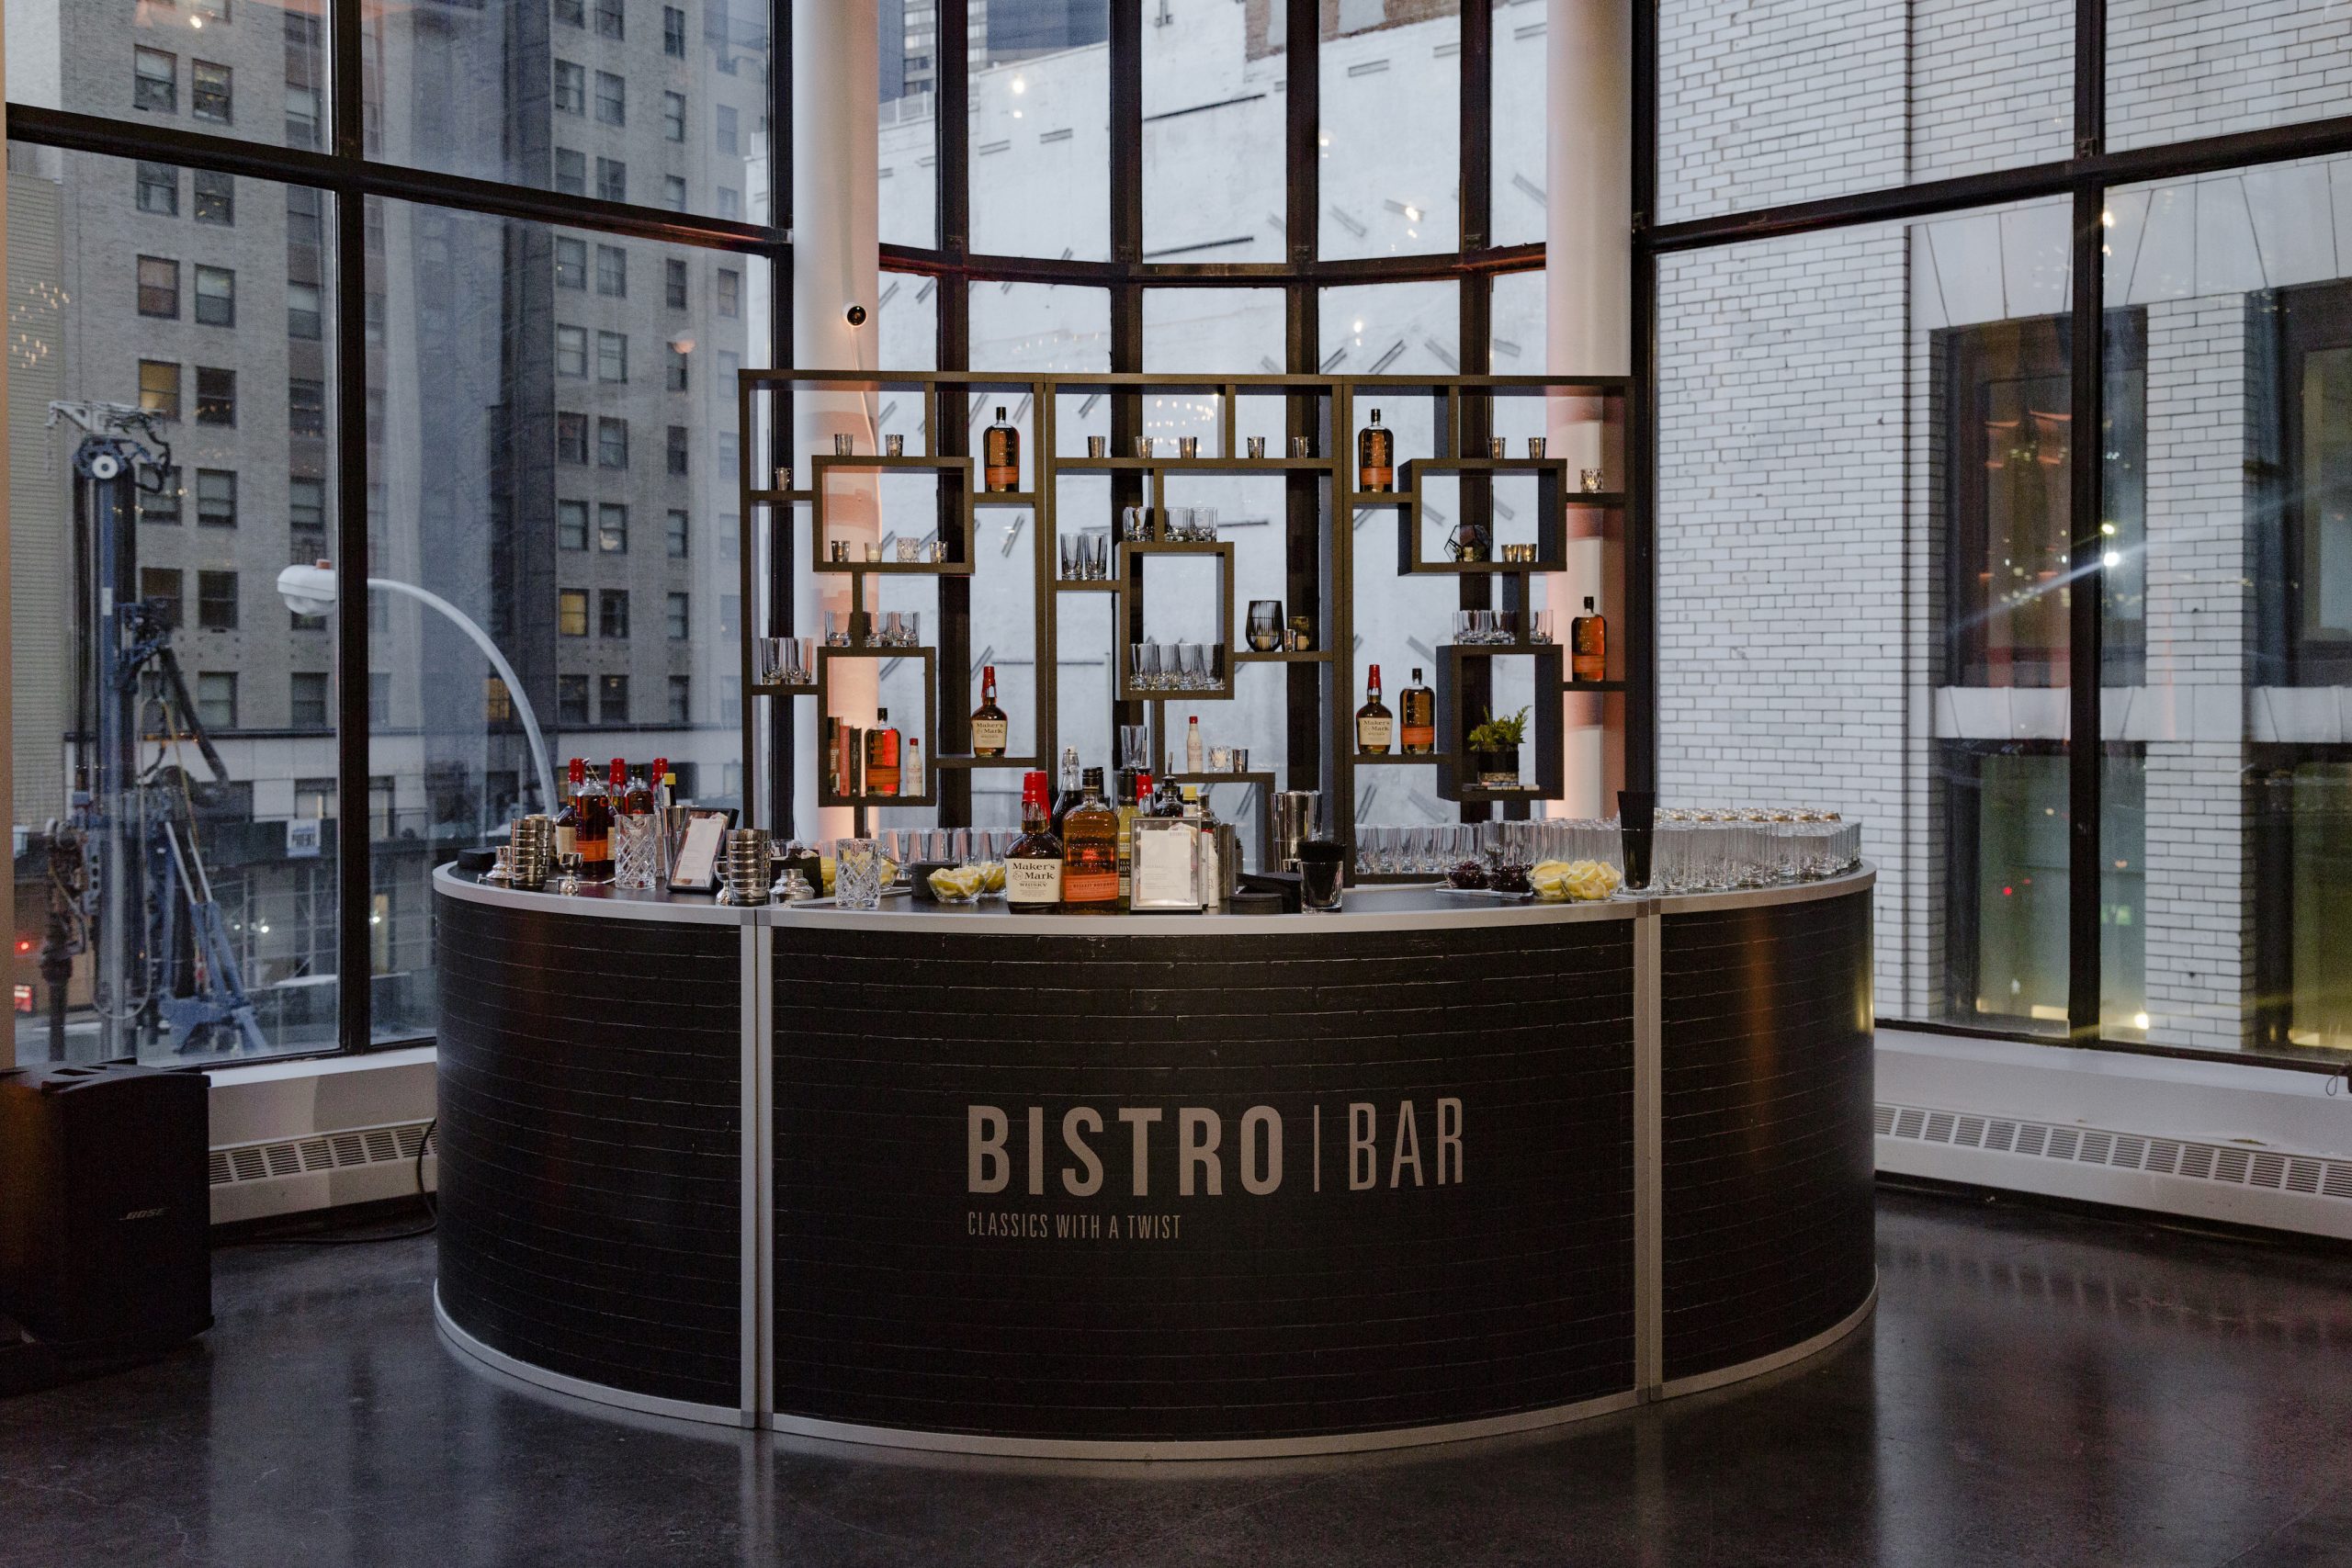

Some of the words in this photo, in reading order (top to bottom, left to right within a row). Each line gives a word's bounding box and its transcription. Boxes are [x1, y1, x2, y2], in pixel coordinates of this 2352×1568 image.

[1012, 863, 1056, 871] Maker's
[1024, 872, 1055, 880] Mark
[967, 1104, 1283, 1197] BISTRO
[1349, 1097, 1464, 1191] BAR
[119, 1205, 171, 1221] BOSE
[967, 1211, 1048, 1238] CLASSICS
[1057, 1214, 1100, 1239] WITH
[1109, 1214, 1119, 1239] A
[1127, 1214, 1181, 1239] TWIST
